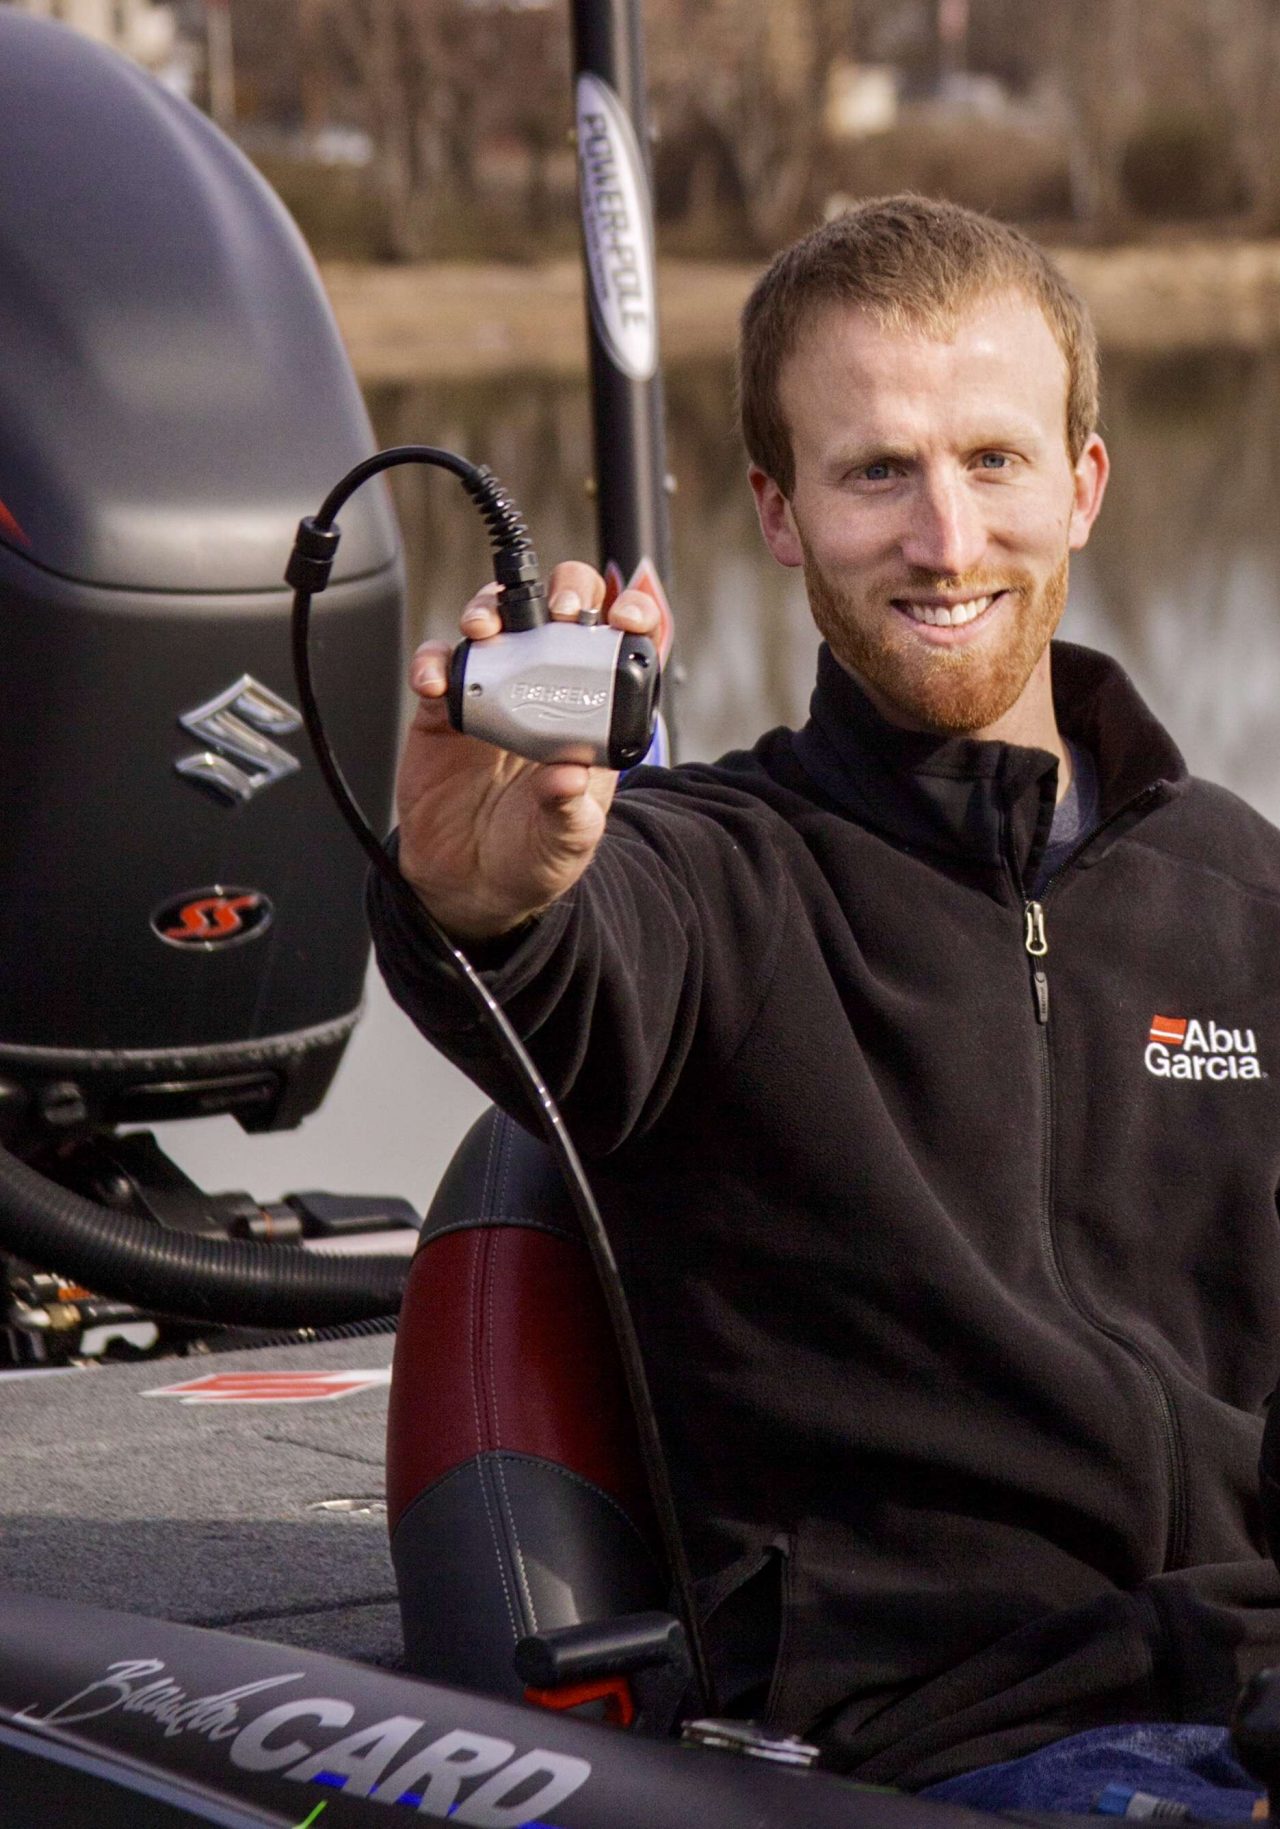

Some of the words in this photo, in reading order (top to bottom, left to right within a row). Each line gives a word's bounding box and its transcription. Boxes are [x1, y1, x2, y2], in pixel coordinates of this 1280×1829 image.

[583, 112, 648, 329] POWER-POLE
[1144, 1041, 1262, 1081] Garcia
[1183, 1018, 1258, 1054] Abu
[229, 1697, 593, 1829] CARD
